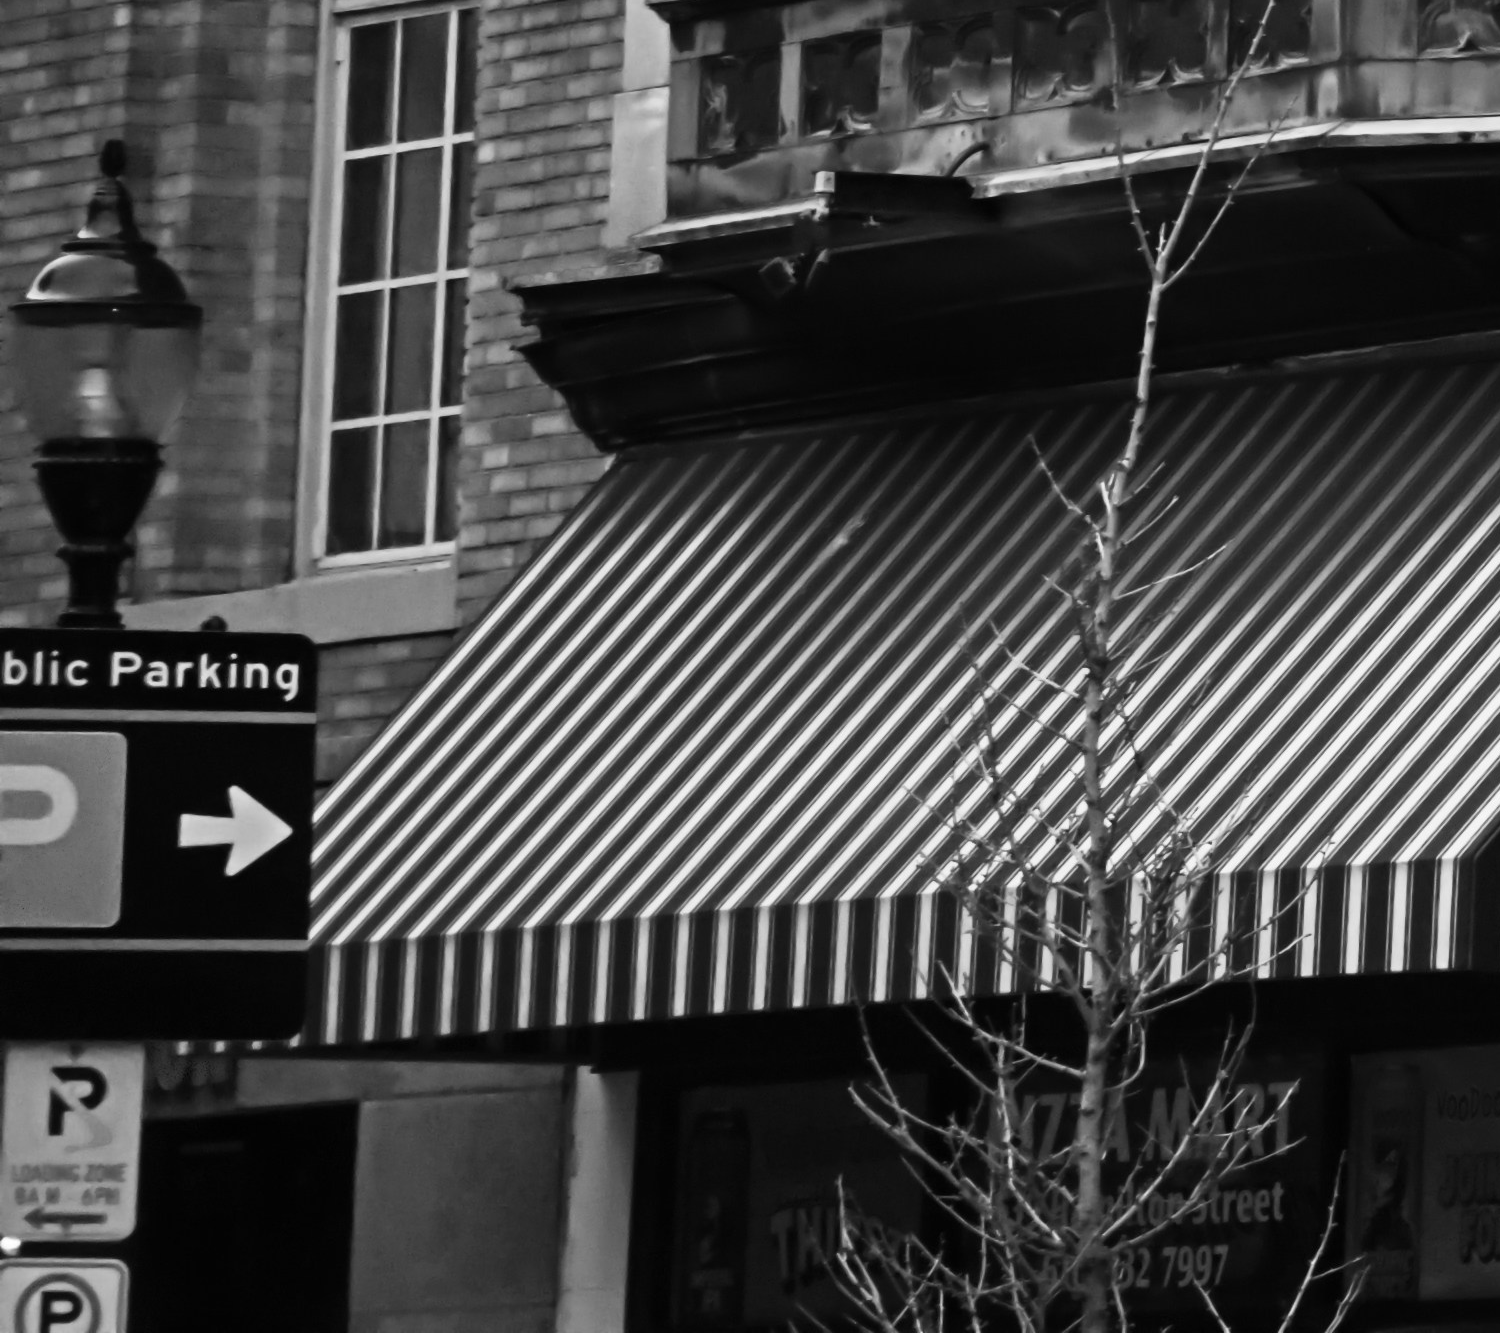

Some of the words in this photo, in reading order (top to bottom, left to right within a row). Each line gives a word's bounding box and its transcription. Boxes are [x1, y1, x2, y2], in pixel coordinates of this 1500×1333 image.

[110, 652, 301, 702] Parking
[1144, 1081, 1299, 1161] MART
[84, 1162, 128, 1182] ZONE
[1162, 1244, 1229, 1288] 7997
